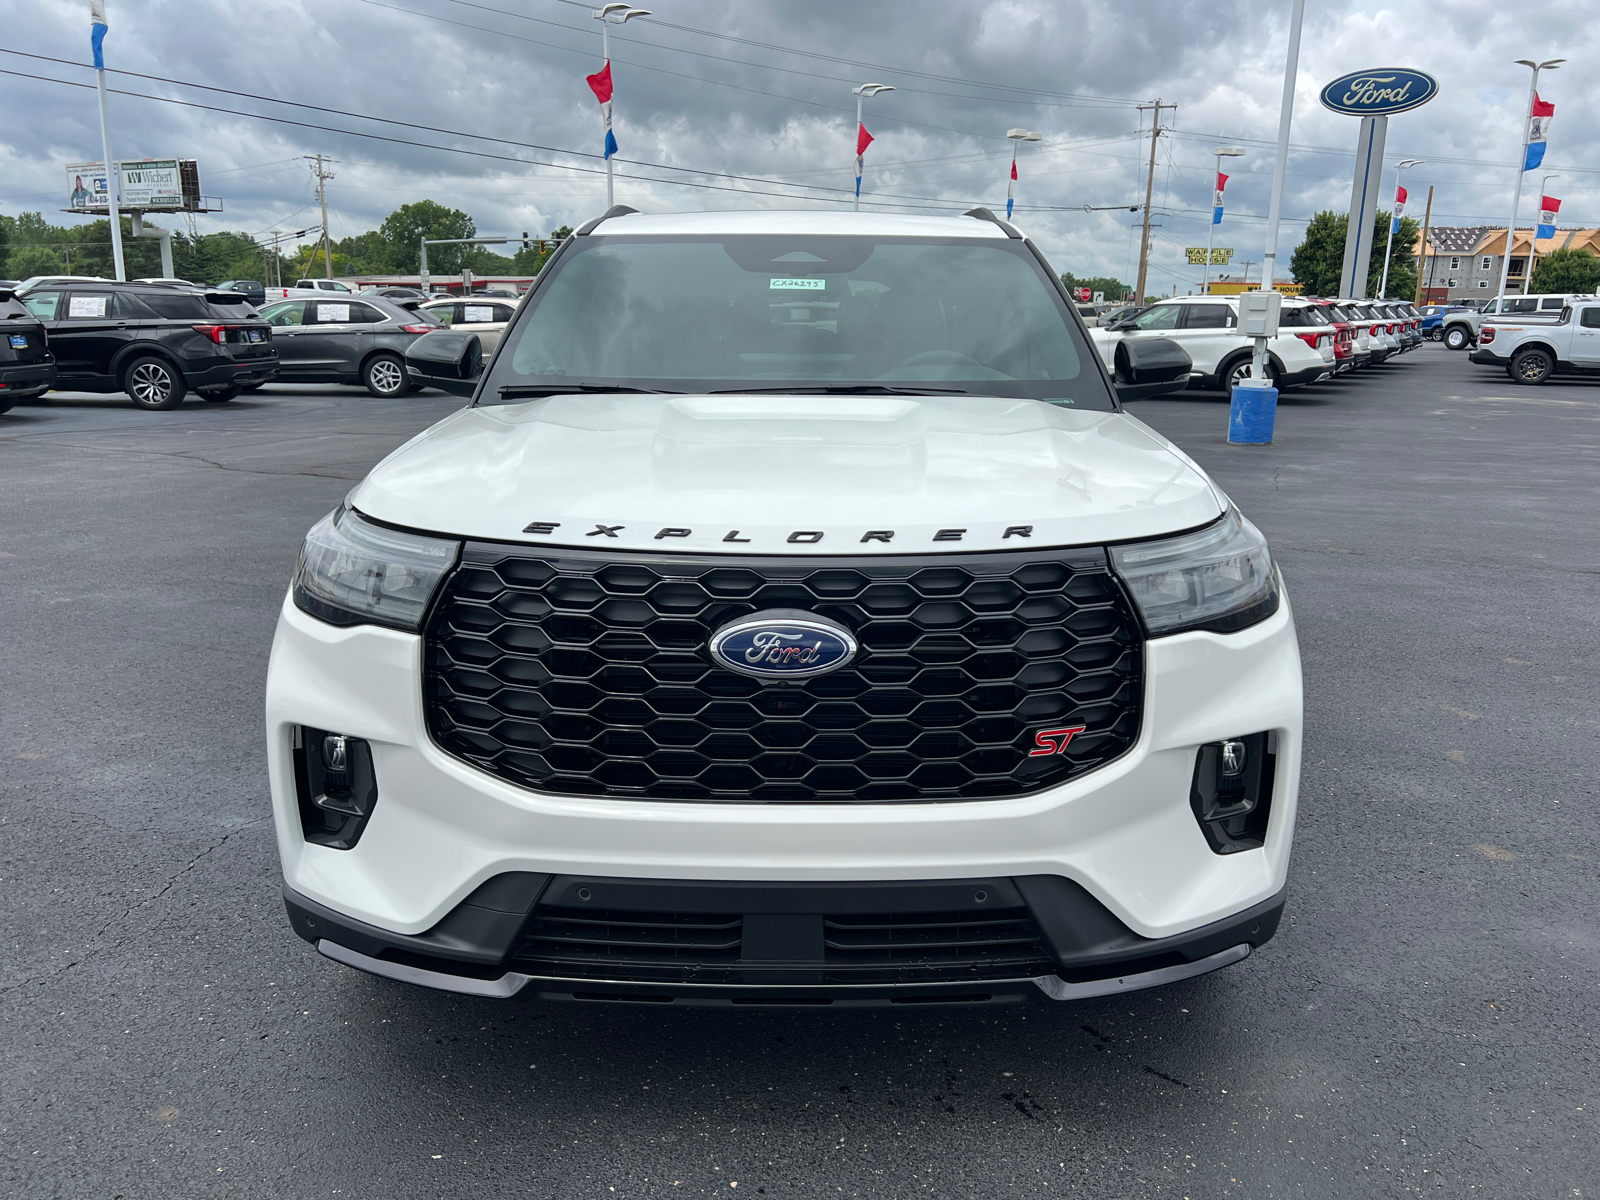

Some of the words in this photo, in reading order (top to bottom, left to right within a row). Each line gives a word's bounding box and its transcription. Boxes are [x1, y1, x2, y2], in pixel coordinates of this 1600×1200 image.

[1342, 76, 1413, 106] Ford
[142, 170, 173, 183] Wichert
[522, 520, 1034, 544] EXPLORER
[744, 631, 822, 664] Ford
[1027, 724, 1087, 758] ST
